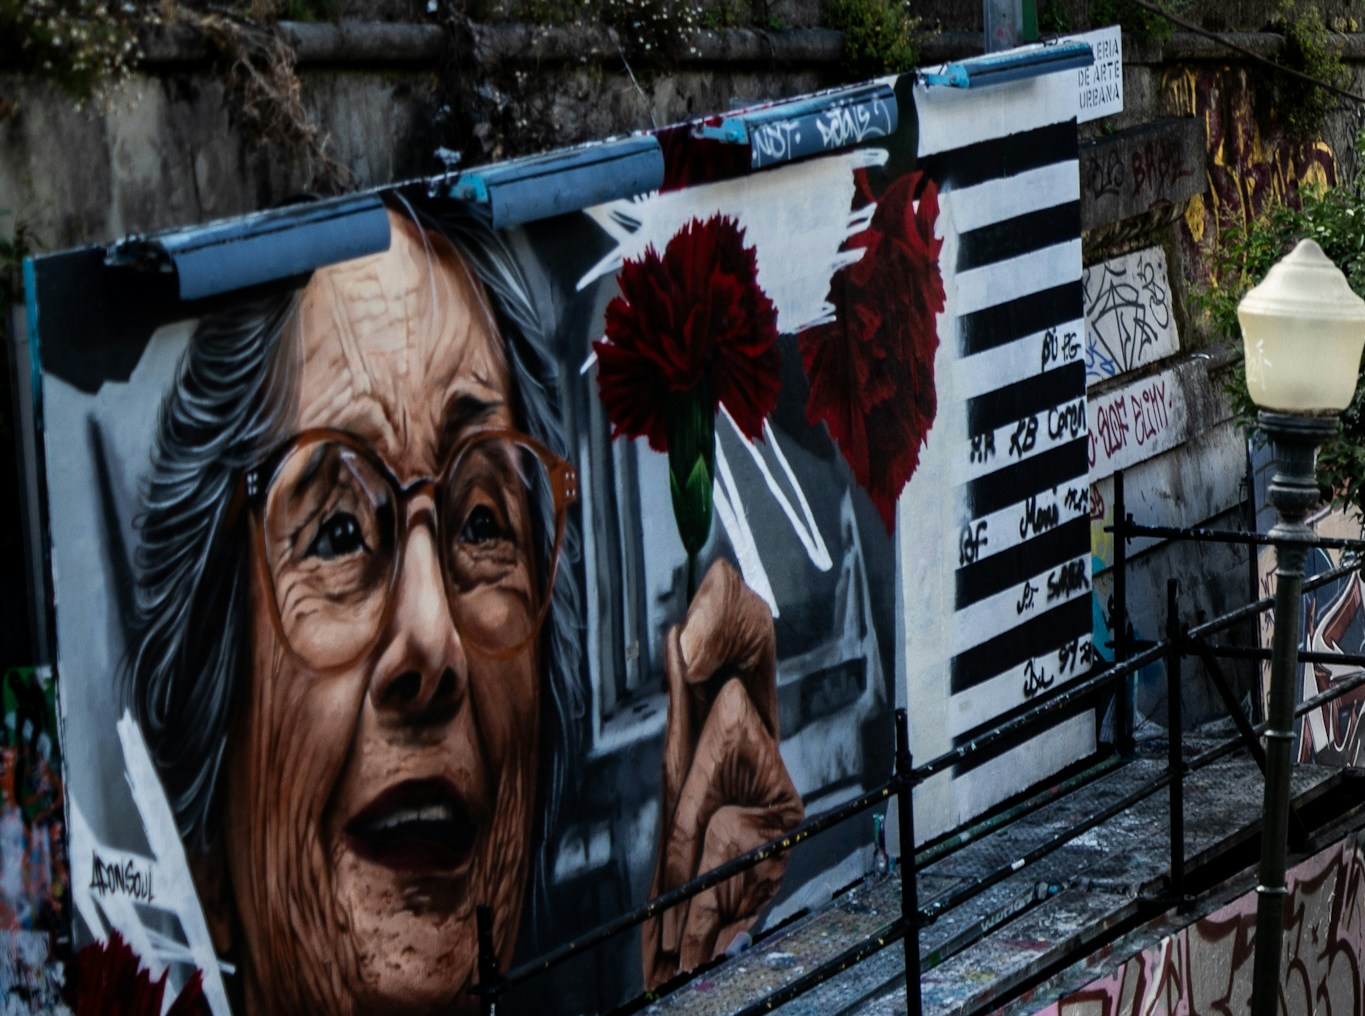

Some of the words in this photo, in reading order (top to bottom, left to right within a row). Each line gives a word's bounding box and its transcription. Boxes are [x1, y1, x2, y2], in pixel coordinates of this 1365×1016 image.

[1096, 38, 1120, 61] ERIA
[1077, 66, 1090, 89] DE
[1093, 60, 1120, 84] ARTE
[1079, 81, 1120, 110] URBANA
